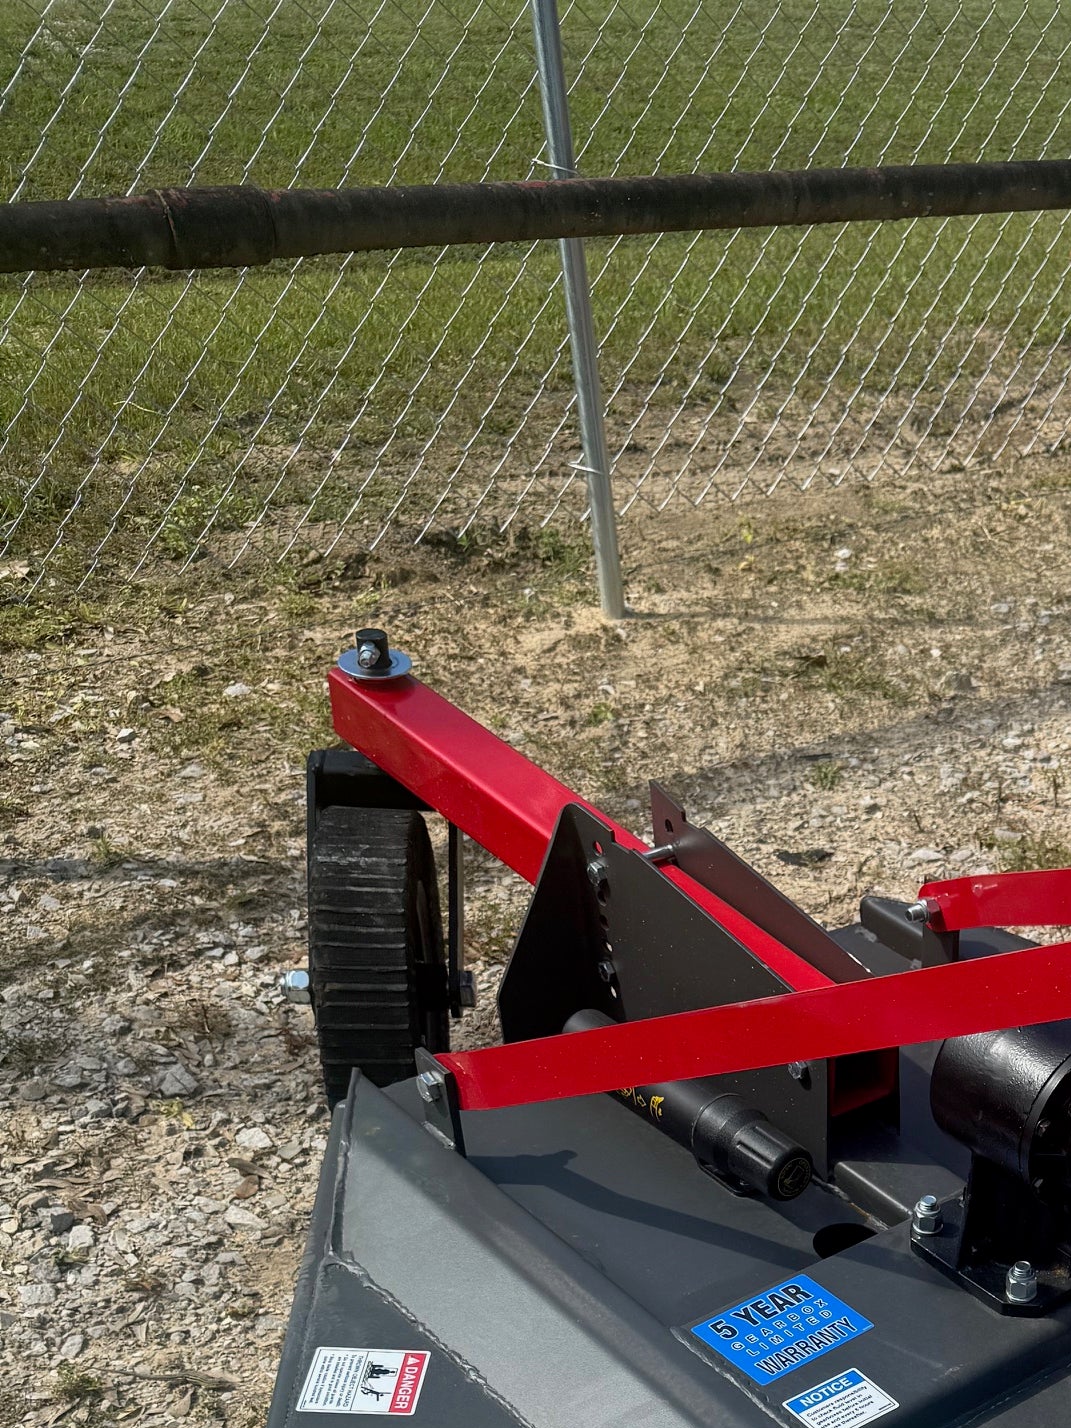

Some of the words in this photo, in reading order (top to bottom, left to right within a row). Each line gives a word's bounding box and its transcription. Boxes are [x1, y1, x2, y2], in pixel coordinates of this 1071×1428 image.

[708, 1318, 739, 1340] 5
[731, 1283, 814, 1327] YEAR
[730, 1298, 828, 1351] GEARBOX
[746, 1309, 832, 1357] LIMITED
[755, 1317, 858, 1376] WARRANTY
[394, 1367, 418, 1409] DANGER
[799, 1377, 853, 1407] NOTICE
